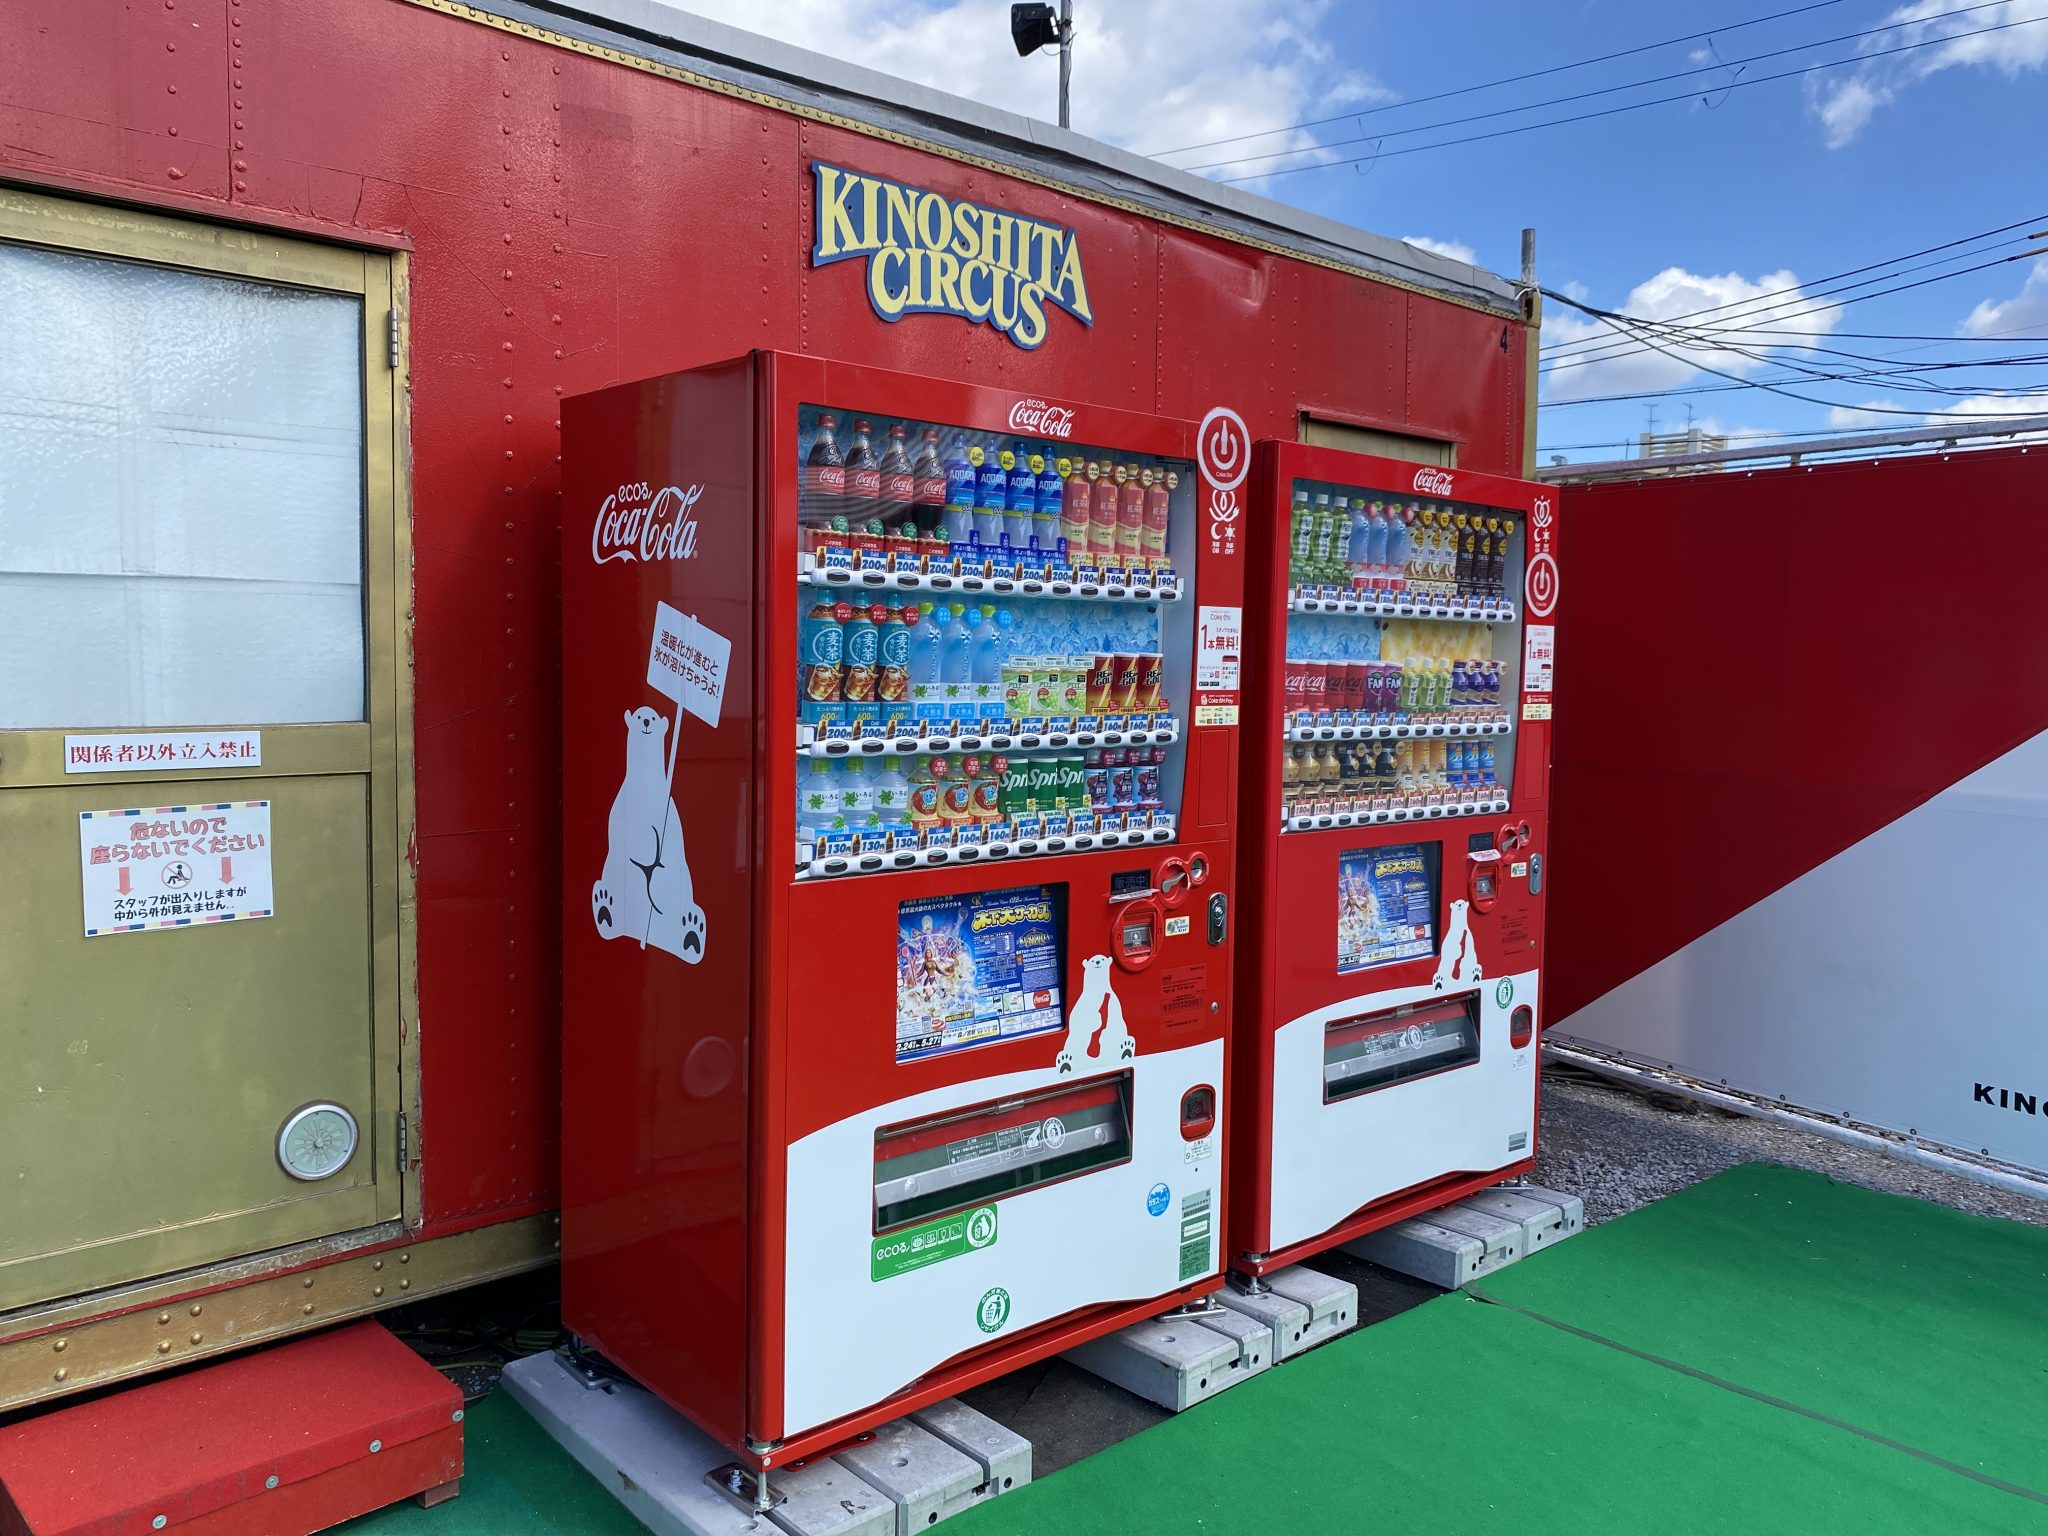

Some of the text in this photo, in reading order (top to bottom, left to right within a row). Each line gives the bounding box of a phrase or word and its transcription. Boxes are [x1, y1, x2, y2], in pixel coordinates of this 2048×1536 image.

[818, 164, 1092, 321] KINOSHITA
[871, 246, 1047, 345] CIRCUS
[1008, 400, 1076, 437] Coca-Cola
[1413, 468, 1455, 496] Coca-Cola
[592, 483, 705, 565] Coca-Cola
[660, 629, 719, 677] 温暖化が進むと
[825, 631, 839, 661] 麦茶
[861, 632, 876, 661] 麦茶
[895, 634, 908, 662] 麦茶
[654, 646, 721, 699] 氷が溶けちゃうよ!
[70, 741, 257, 764] 関係者以外立入禁止
[130, 816, 227, 841] 危ないので
[90, 833, 265, 865] 座らないでください
[114, 886, 247, 910] スタッフが出入りしますが
[972, 902, 1051, 932] 木下大サーカス
[1974, 1082, 2048, 1118] KIN
